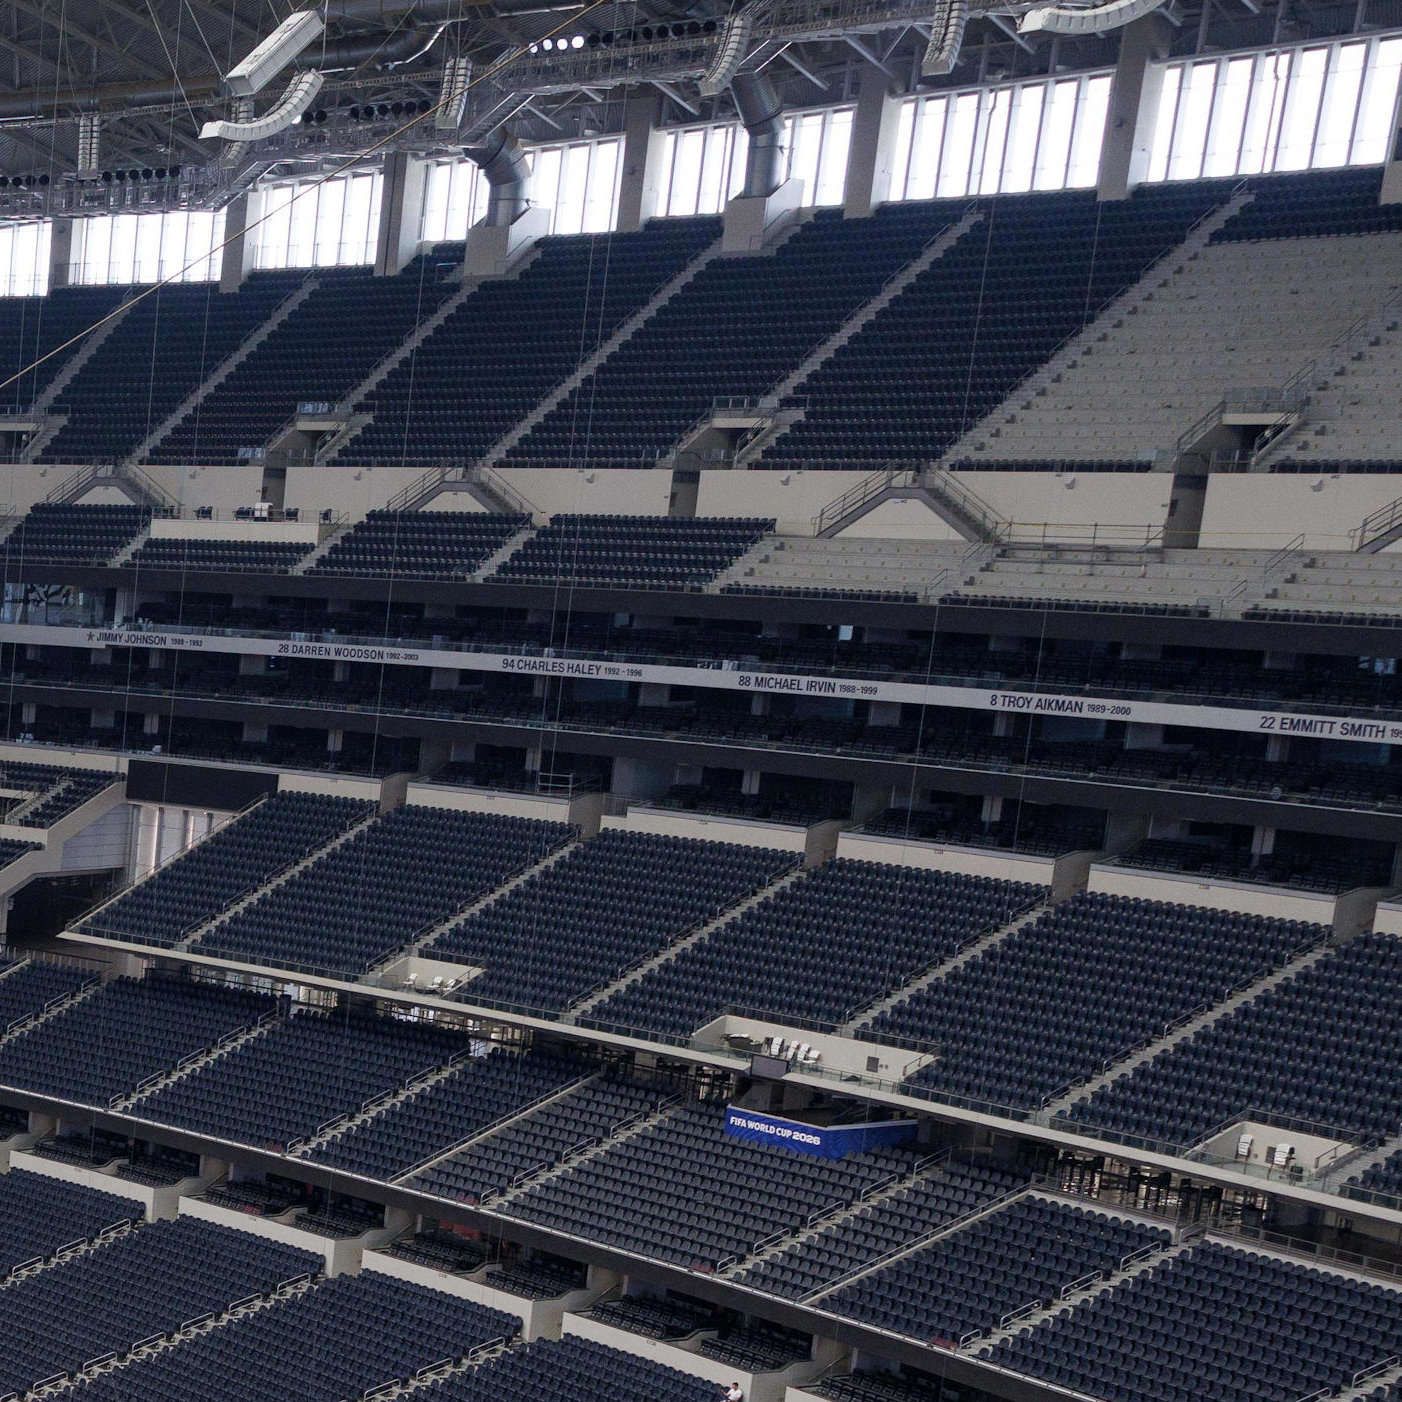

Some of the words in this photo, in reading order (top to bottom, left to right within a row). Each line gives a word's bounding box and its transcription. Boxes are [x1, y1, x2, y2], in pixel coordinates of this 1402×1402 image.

[96, 632, 123, 642] JIMMY
[124, 634, 167, 646] JOHNSON
[278, 643, 289, 653] 28
[291, 645, 331, 657] DARREN
[334, 648, 384, 660] WOODSON
[502, 658, 515, 669] 94
[517, 659, 565, 673] CHARLES
[567, 663, 602, 675] HALEY
[738, 675, 751, 687] 88
[754, 676, 803, 691] MICHAEL
[805, 679, 836, 694] IRVIN
[990, 694, 998, 706] 8
[1001, 695, 1033, 709] TROY
[1034, 699, 1084, 714] AIKMAN
[1259, 716, 1276, 729] 22
[1279, 717, 1337, 734] EMMITT
[1339, 722, 1387, 739] SMITH
[729, 1116, 747, 1128] FIFA
[747, 1120, 776, 1135] WORLD
[775, 1127, 793, 1138] CUP
[792, 1131, 821, 1146] 2026
